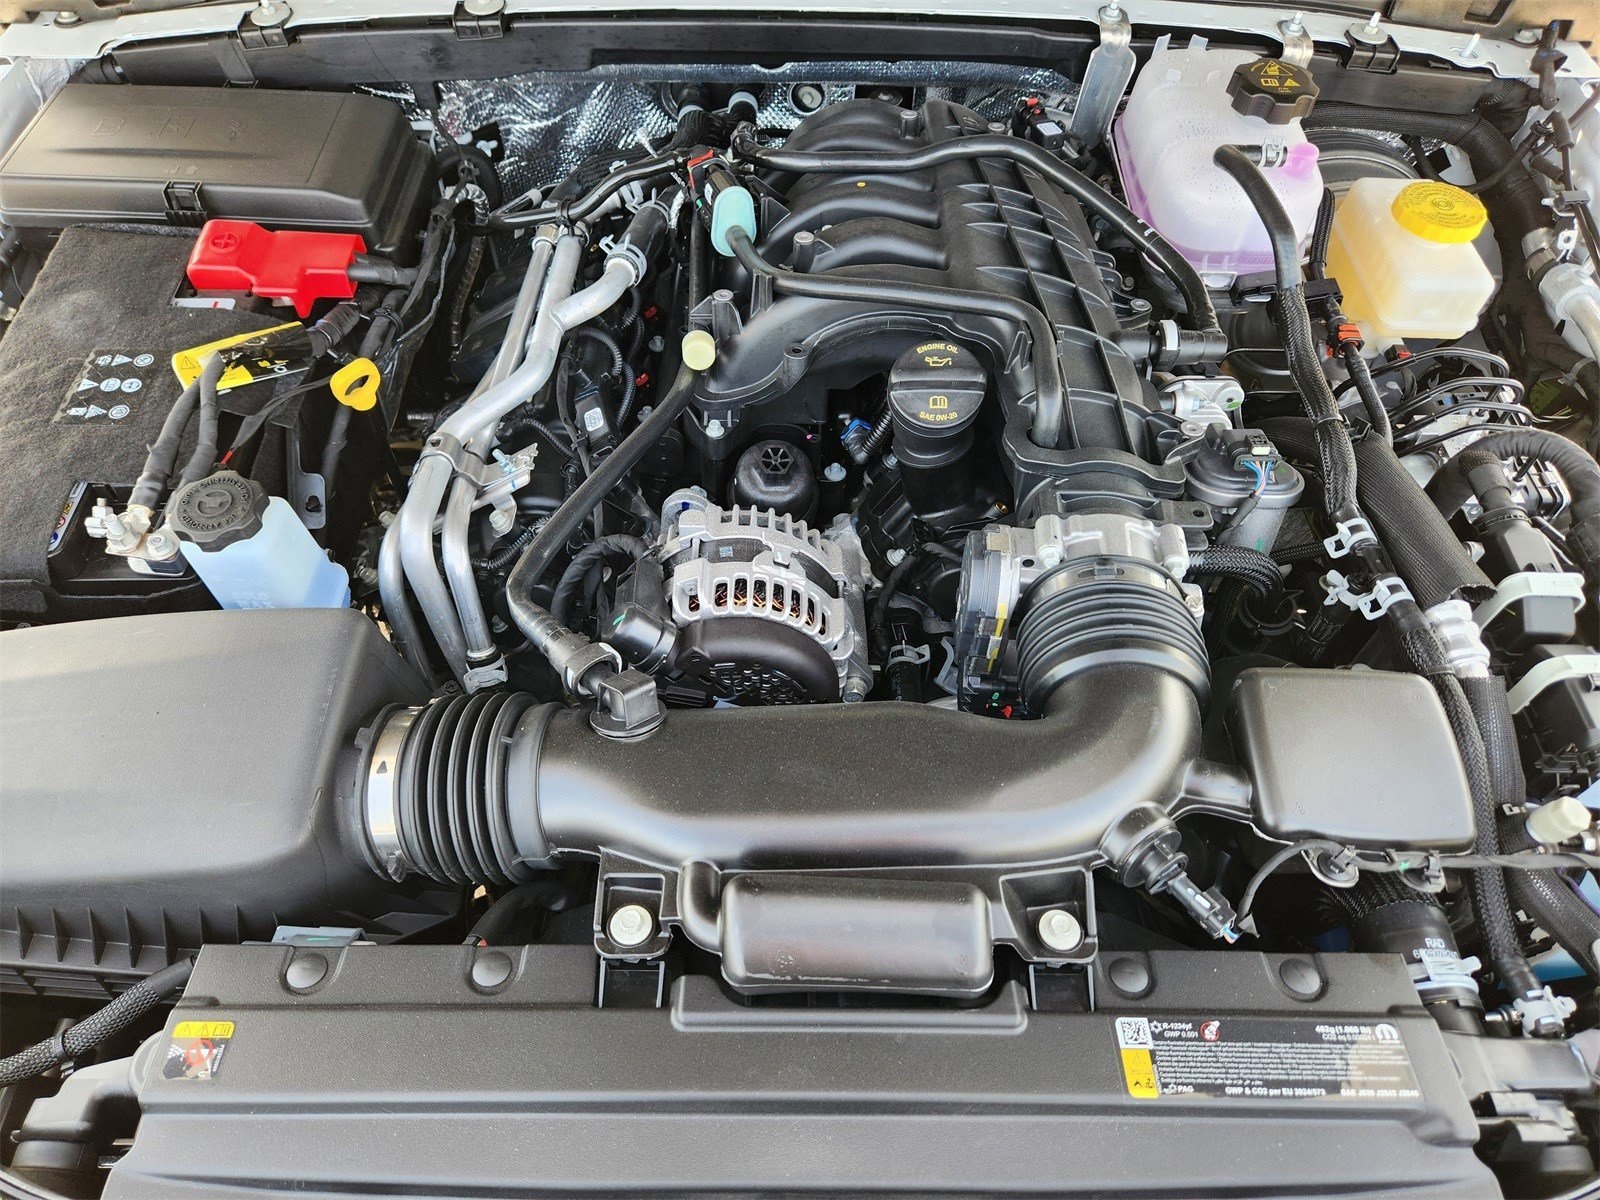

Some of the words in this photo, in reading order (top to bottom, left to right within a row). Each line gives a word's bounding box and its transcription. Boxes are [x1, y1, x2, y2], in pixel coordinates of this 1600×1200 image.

[916, 343, 945, 354] ENGINE
[946, 344, 958, 354] OIL
[919, 411, 934, 421] SAE
[935, 411, 958, 421] 0W-20
[1425, 938, 1445, 948] RAD
[1225, 1087, 1243, 1095] GWP
[1252, 1087, 1268, 1095] CO2
